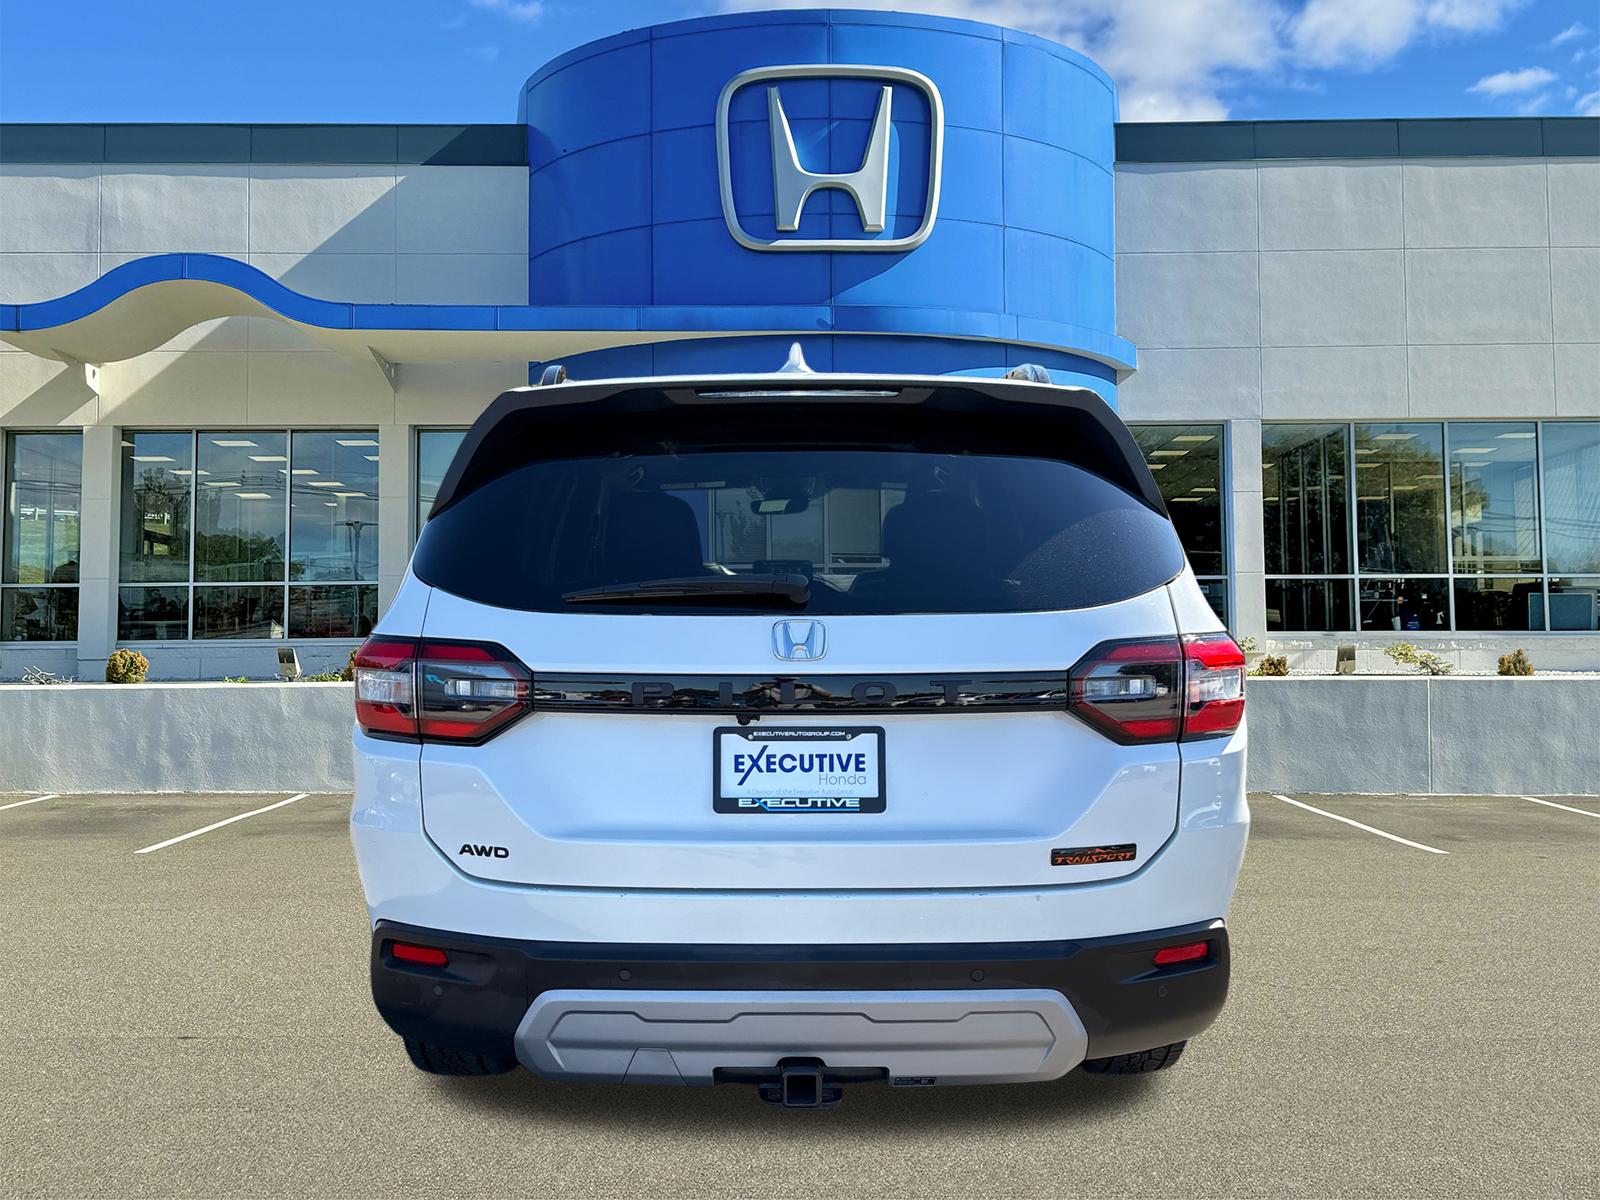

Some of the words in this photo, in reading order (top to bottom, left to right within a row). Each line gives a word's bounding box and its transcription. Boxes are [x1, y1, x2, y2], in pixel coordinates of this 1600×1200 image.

[631, 680, 973, 705] PILOT
[734, 745, 866, 786] EXECUTIVE
[819, 774, 867, 785] Honda
[738, 798, 860, 810] EXECUTIVE
[459, 843, 510, 859] AWD
[1055, 852, 1134, 864] TRAILSPORT
